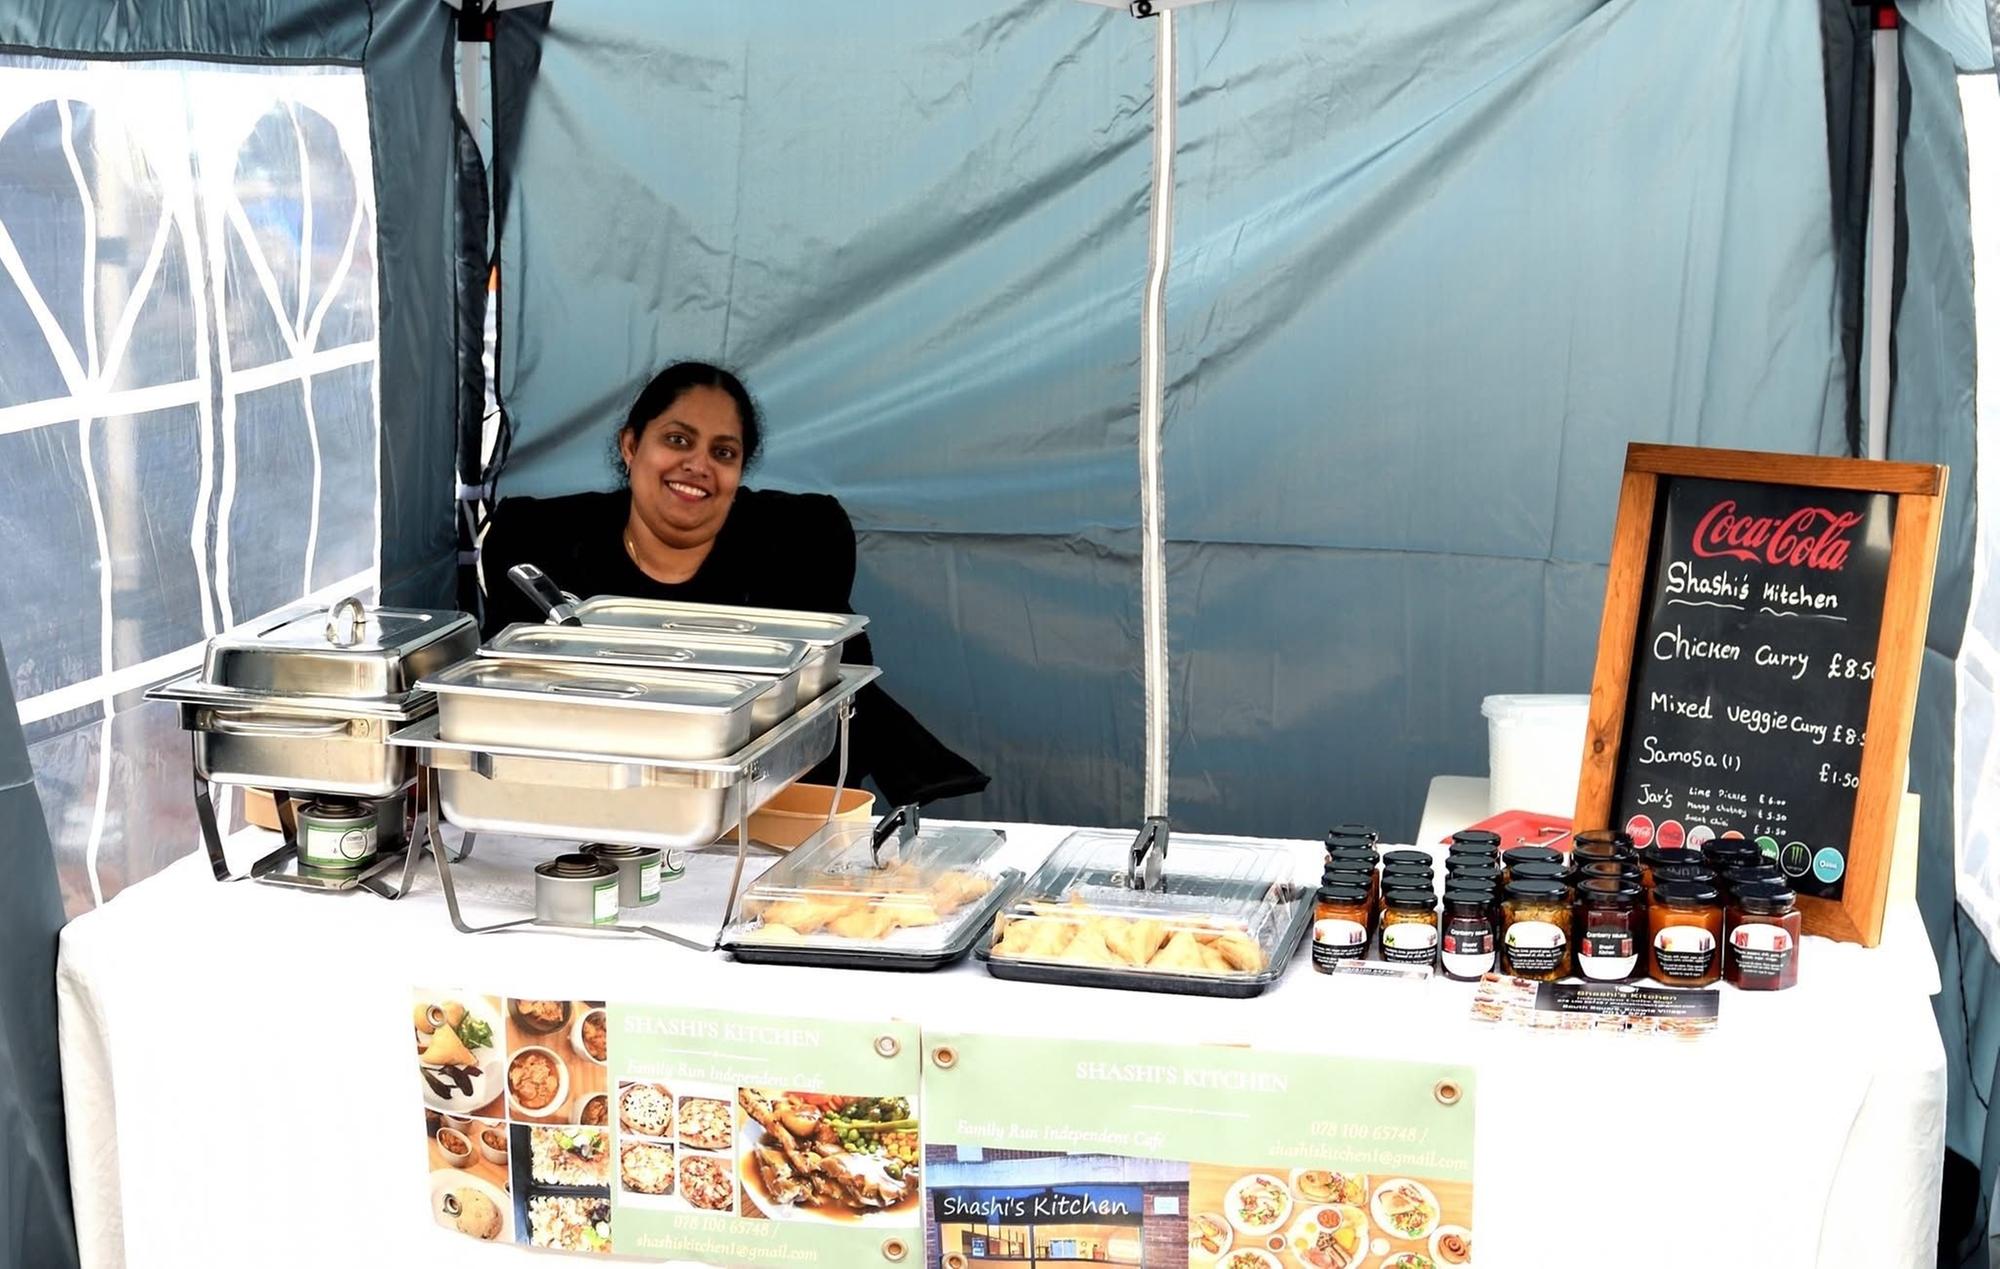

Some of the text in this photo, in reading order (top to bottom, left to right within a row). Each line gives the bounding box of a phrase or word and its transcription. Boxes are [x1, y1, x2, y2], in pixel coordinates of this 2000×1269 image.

[1692, 500, 1864, 571] Coca-Cola
[1665, 560, 1839, 609] Shashi's Kitchen
[1653, 624, 1741, 661] Chicken
[1754, 645, 1809, 680] Curry
[1650, 691, 1713, 719] Mixed
[1790, 716, 1828, 745] Curry
[1639, 736, 1718, 768] Samosa
[1818, 763, 1860, 789] £1.50
[1637, 783, 1674, 809] Jar's
[624, 1015, 822, 1047] SHASHI'S KITCHEN
[626, 1058, 674, 1079] Family
[678, 1061, 705, 1078] Run
[1075, 1060, 1289, 1095] SHASHI'S KITCHEN
[956, 1118, 1003, 1140] Family
[1008, 1123, 1039, 1140] Run
[1043, 1124, 1129, 1147] Independent
[1310, 1121, 1337, 1137] 078
[1342, 1123, 1369, 1138] 100
[943, 1192, 1129, 1217] Shashi's Kitchen
[672, 1214, 698, 1231] 078
[702, 1216, 726, 1233] 100
